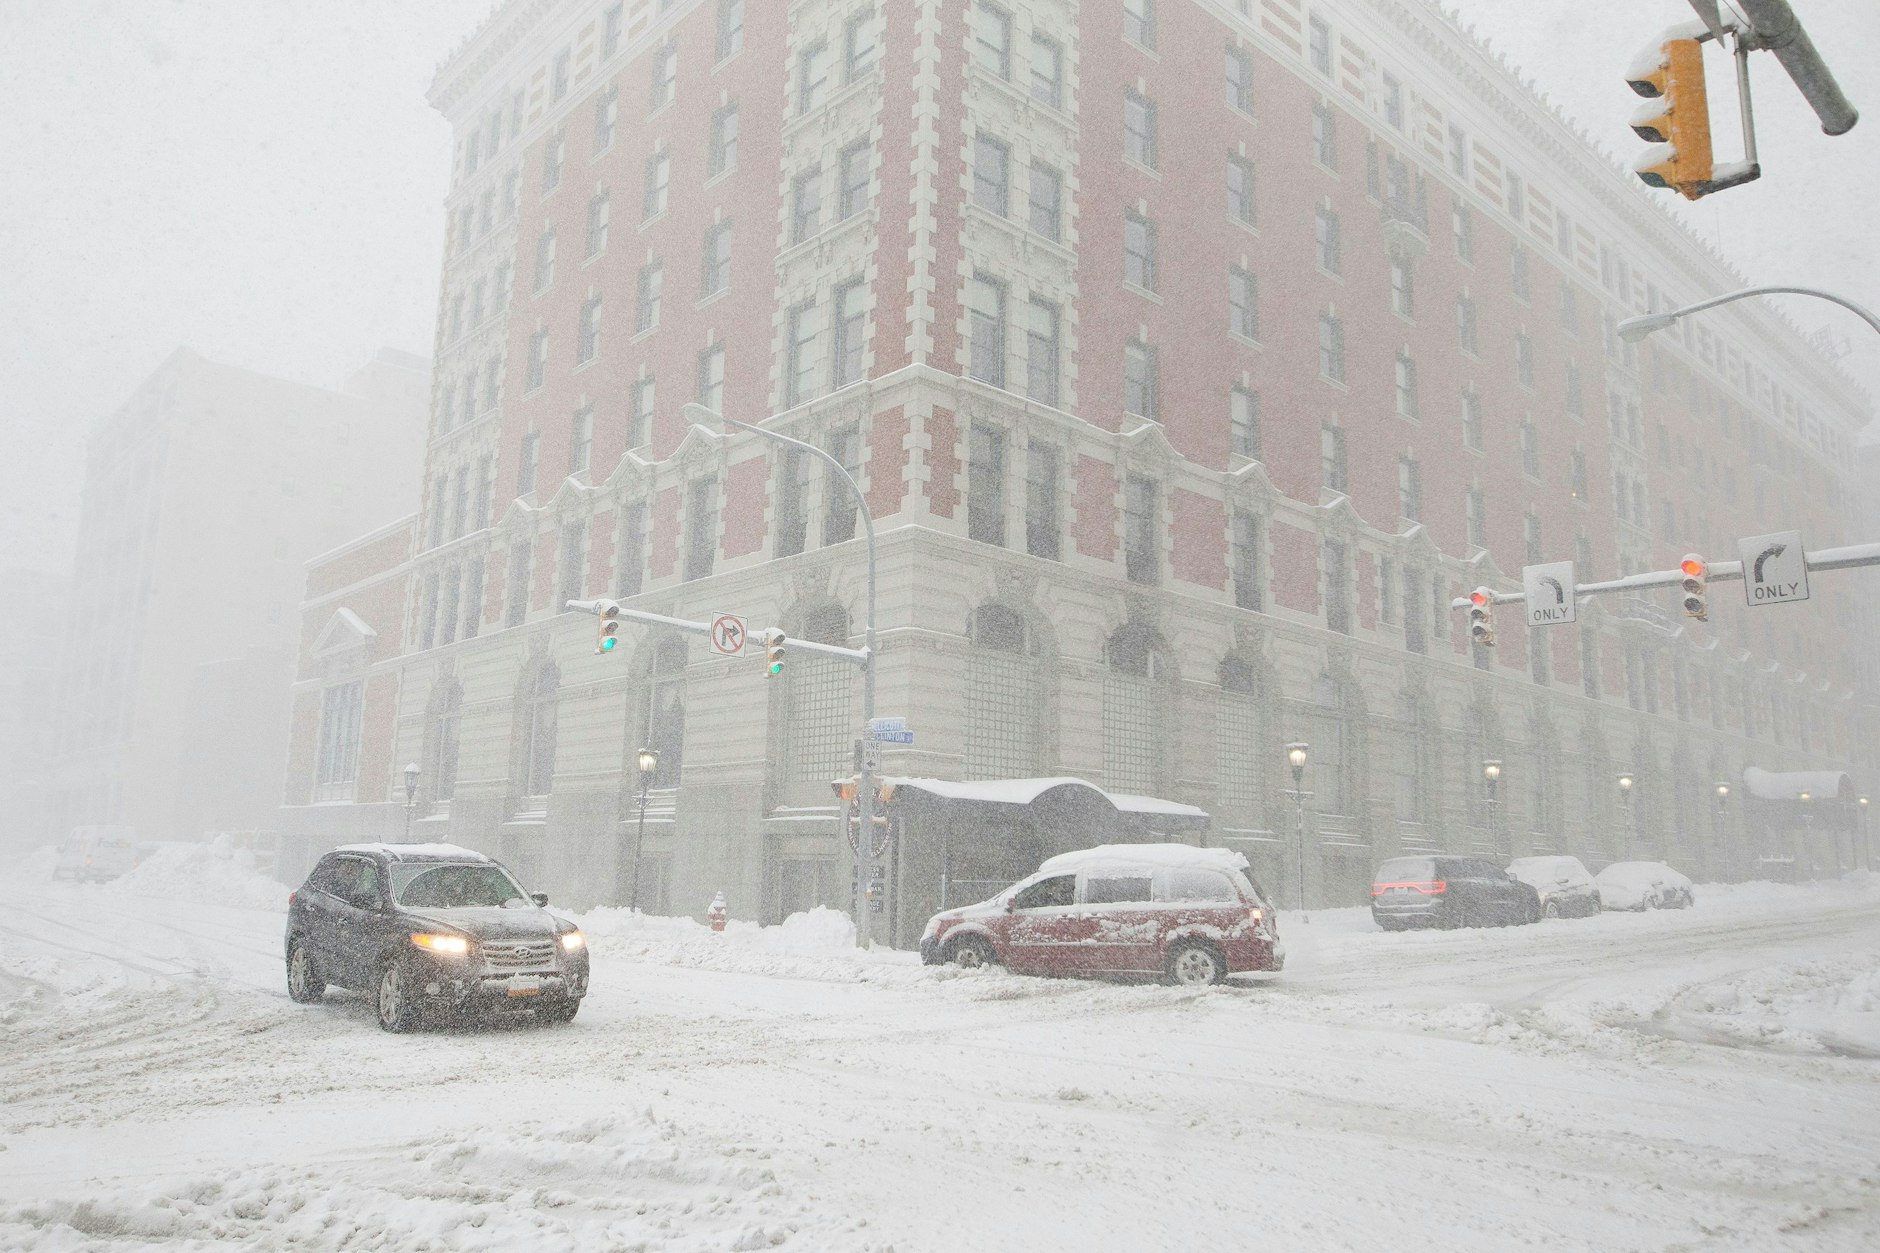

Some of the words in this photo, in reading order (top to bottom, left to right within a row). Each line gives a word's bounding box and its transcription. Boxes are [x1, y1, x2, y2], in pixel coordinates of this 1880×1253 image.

[1754, 582, 1799, 600] ONLY
[1533, 606, 1568, 621] ONLY
[876, 731, 904, 742] CLINTON
[865, 742, 880, 750] ONE
[865, 751, 880, 759] WAY
